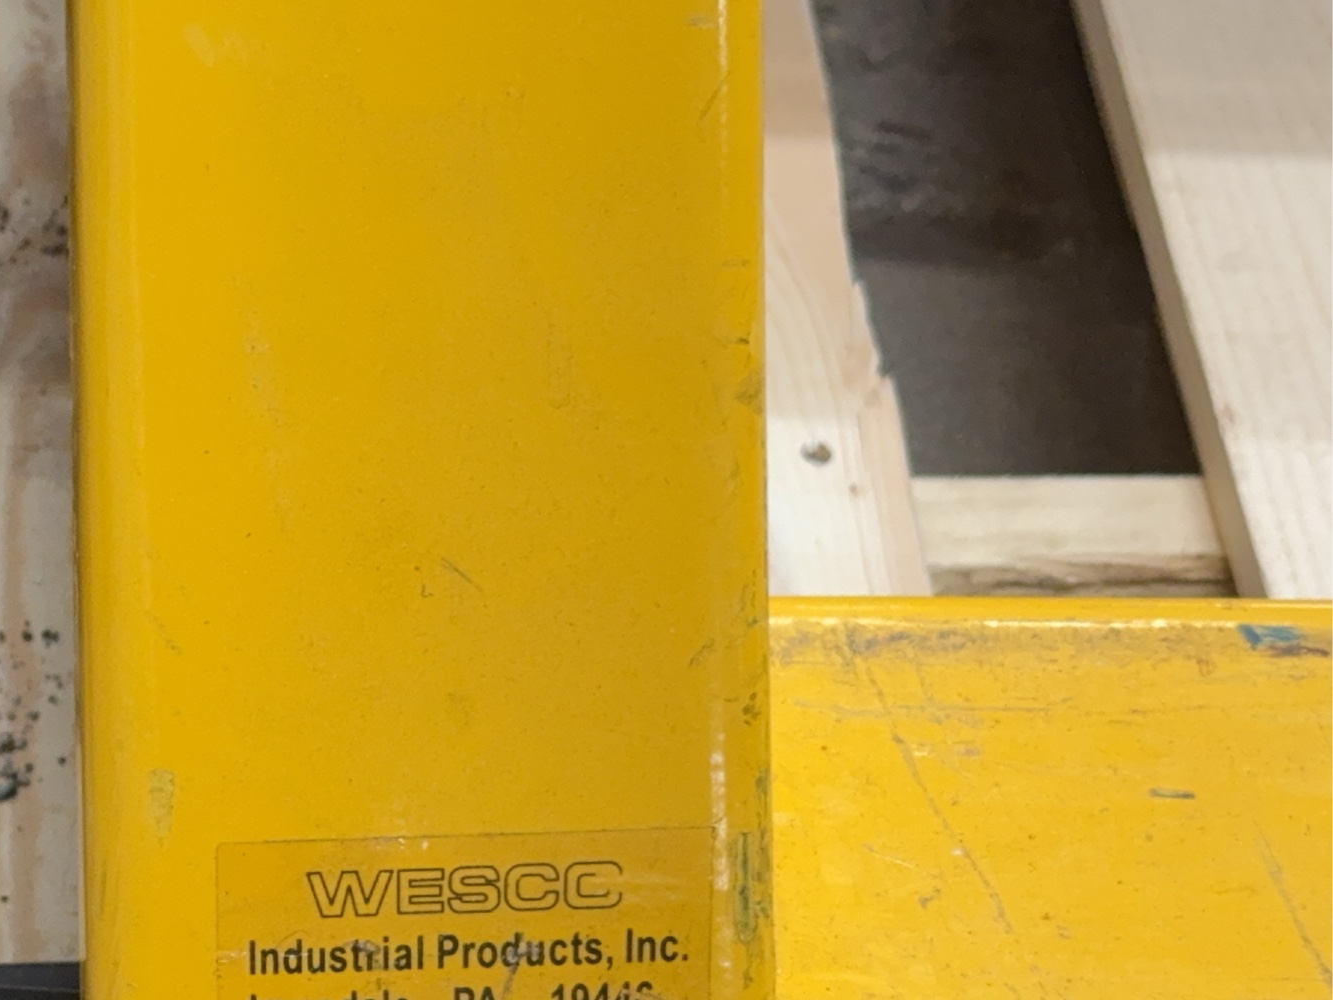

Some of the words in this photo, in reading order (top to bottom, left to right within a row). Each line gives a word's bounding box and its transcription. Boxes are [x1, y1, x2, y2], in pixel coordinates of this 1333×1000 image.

[249, 934, 424, 975] Industrial
[438, 931, 613, 971] Products,
[626, 928, 688, 963] Inc.
